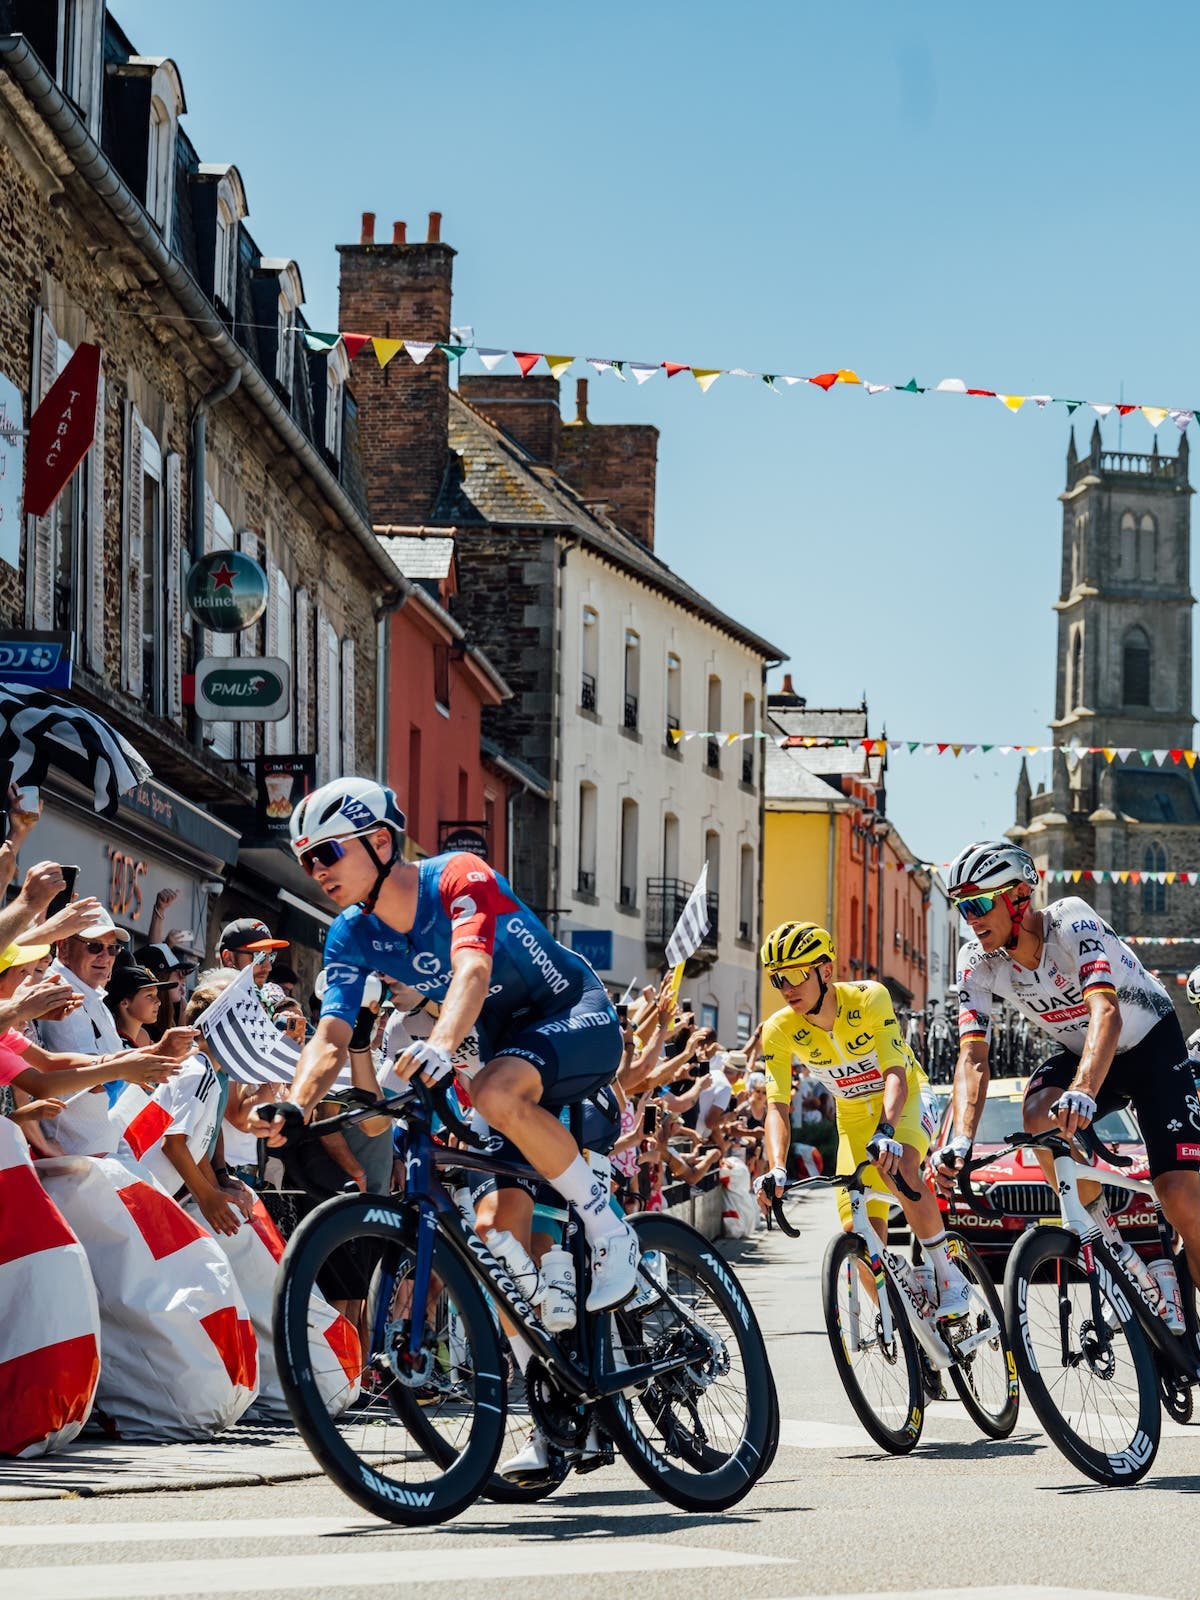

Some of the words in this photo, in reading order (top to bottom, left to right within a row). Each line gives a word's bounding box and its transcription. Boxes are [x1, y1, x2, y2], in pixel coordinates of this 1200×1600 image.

[46, 390, 80, 467] TABAC
[0, 647, 28, 667] DJ
[211, 682, 247, 696] PMU
[506, 917, 570, 995] Groupama
[1028, 986, 1083, 1013] UAE
[1047, 1006, 1088, 1021] Emirate
[847, 1031, 874, 1051] LCL
[829, 1058, 876, 1079] UAE
[839, 1072, 877, 1086] Emirates
[1102, 1239, 1159, 1317] COLNAGO
[700, 1252, 752, 1332] MICHE
[359, 1465, 435, 1507] MICHE
